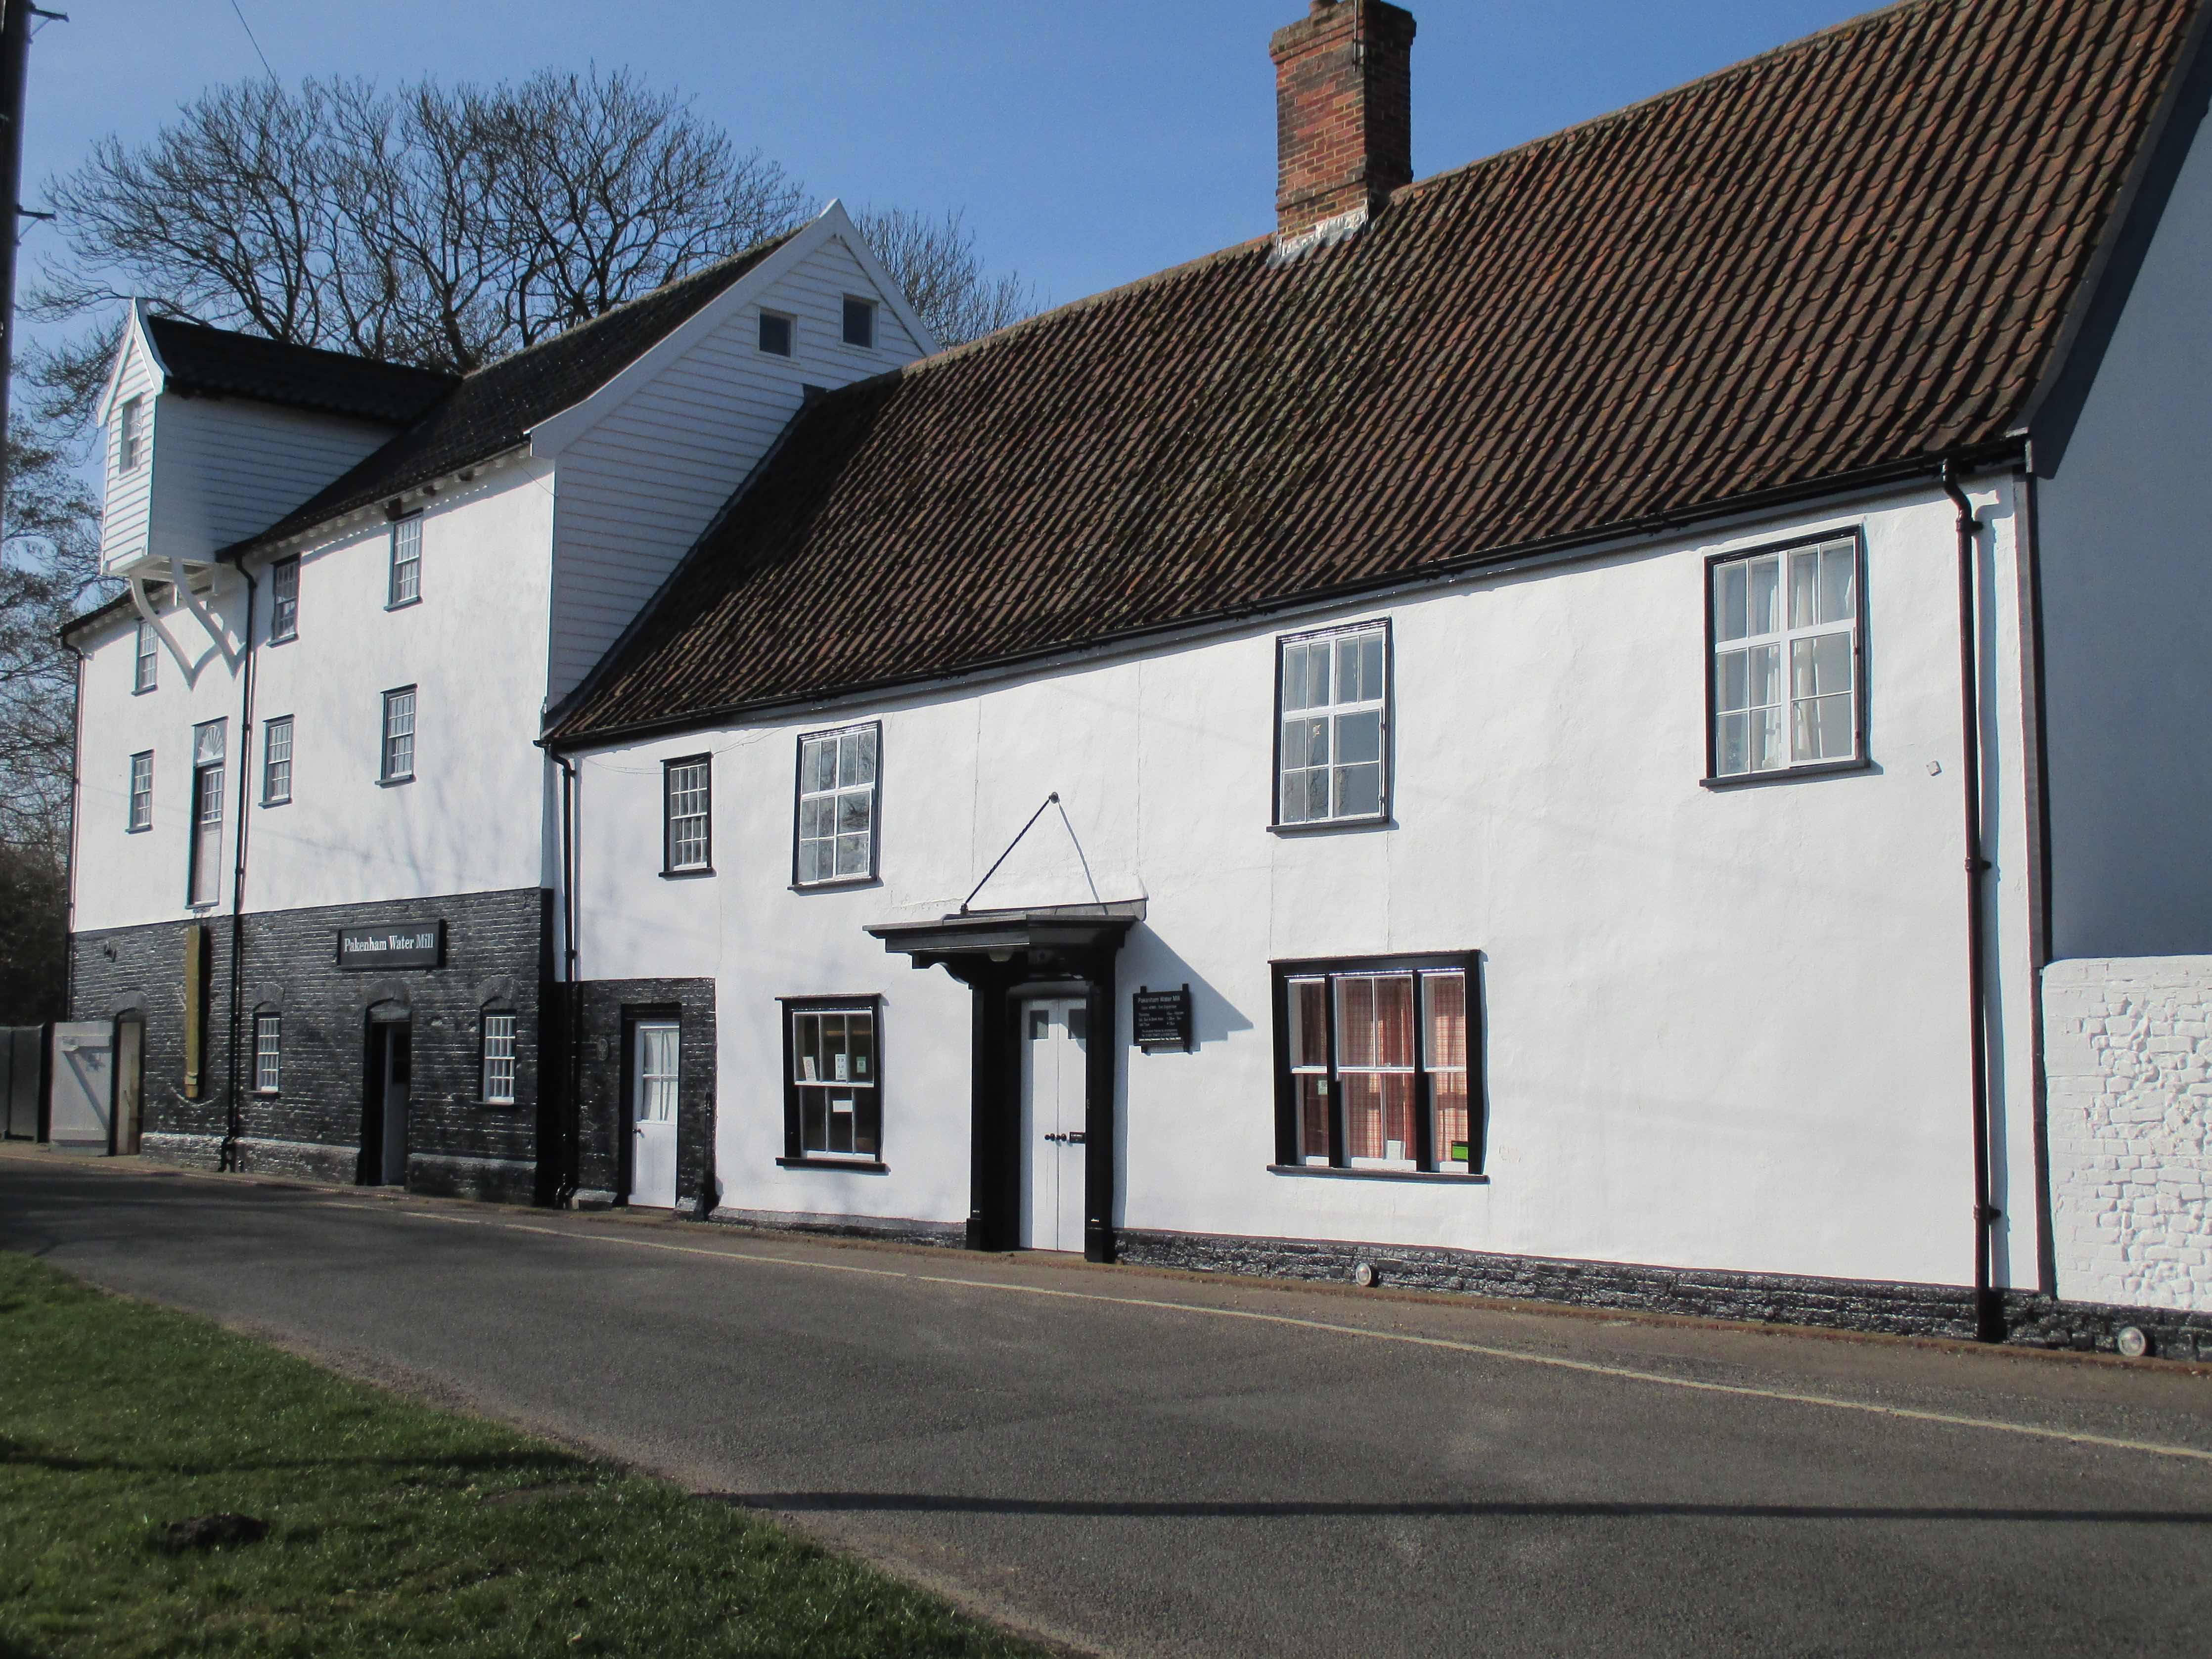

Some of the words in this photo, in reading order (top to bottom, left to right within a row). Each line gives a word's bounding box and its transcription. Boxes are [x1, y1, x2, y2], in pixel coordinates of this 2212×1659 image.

[344, 937, 387, 952] Pakenham
[389, 935, 415, 950] Water
[416, 933, 434, 948] Mill
